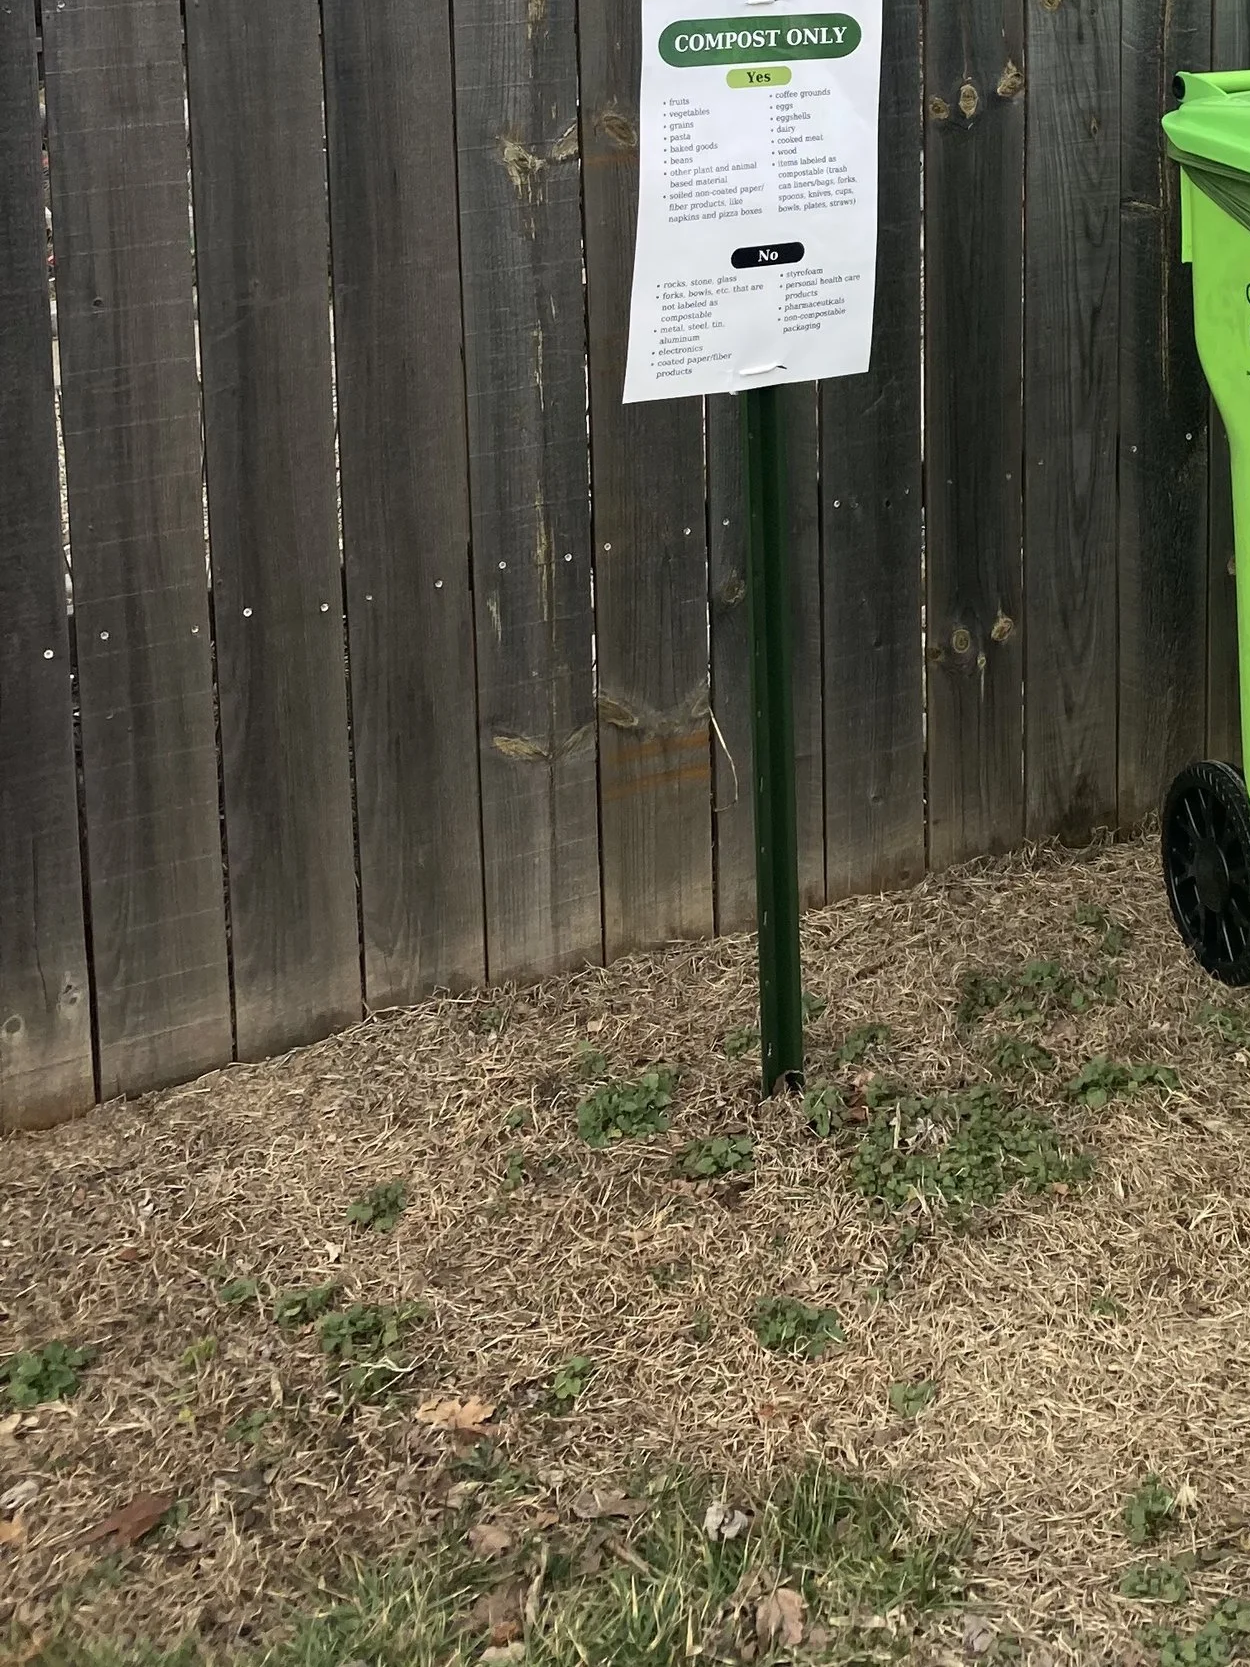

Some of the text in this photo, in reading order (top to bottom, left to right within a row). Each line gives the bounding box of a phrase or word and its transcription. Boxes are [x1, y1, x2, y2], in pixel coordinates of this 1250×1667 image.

[675, 27, 847, 51] COMPOST ONLY
[746, 72, 771, 83] Yes
[775, 88, 831, 99] coffee grounds
[669, 98, 690, 106] fruits
[776, 103, 794, 112] eggs
[669, 108, 710, 119] vegetables
[776, 112, 811, 123] eggshells
[669, 122, 694, 132] grains
[776, 125, 796, 134] dairy
[670, 133, 691, 143] pasta
[777, 134, 824, 144] cooked meat
[670, 142, 718, 153] baked goods
[777, 147, 797, 155] wood
[670, 157, 693, 165] beans
[800, 156, 826, 165] labeled
[670, 161, 757, 176] other plant and animal
[778, 165, 848, 178] compostable (trash
[670, 176, 728, 188] based material
[669, 184, 765, 200] soiled non-coated paper/
[669, 203, 688, 211] fiber
[729, 198, 743, 206] like
[668, 208, 763, 223] napkins and pizza boxes
[758, 249, 779, 262] No
[716, 276, 737, 285] glass
[785, 279, 818, 290] personal
[820, 275, 843, 285] health
[733, 285, 749, 293] that
[785, 291, 818, 301] products
[677, 300, 707, 309] labeled
[784, 298, 845, 312] pharmaceuticals
[661, 311, 712, 322] compostable
[784, 308, 846, 322] non-compostable
[783, 323, 821, 334] packaging
[659, 335, 700, 345] aluminum
[658, 346, 703, 355] electronics
[657, 353, 732, 367] coated paper/fiber
[656, 368, 693, 379] products
